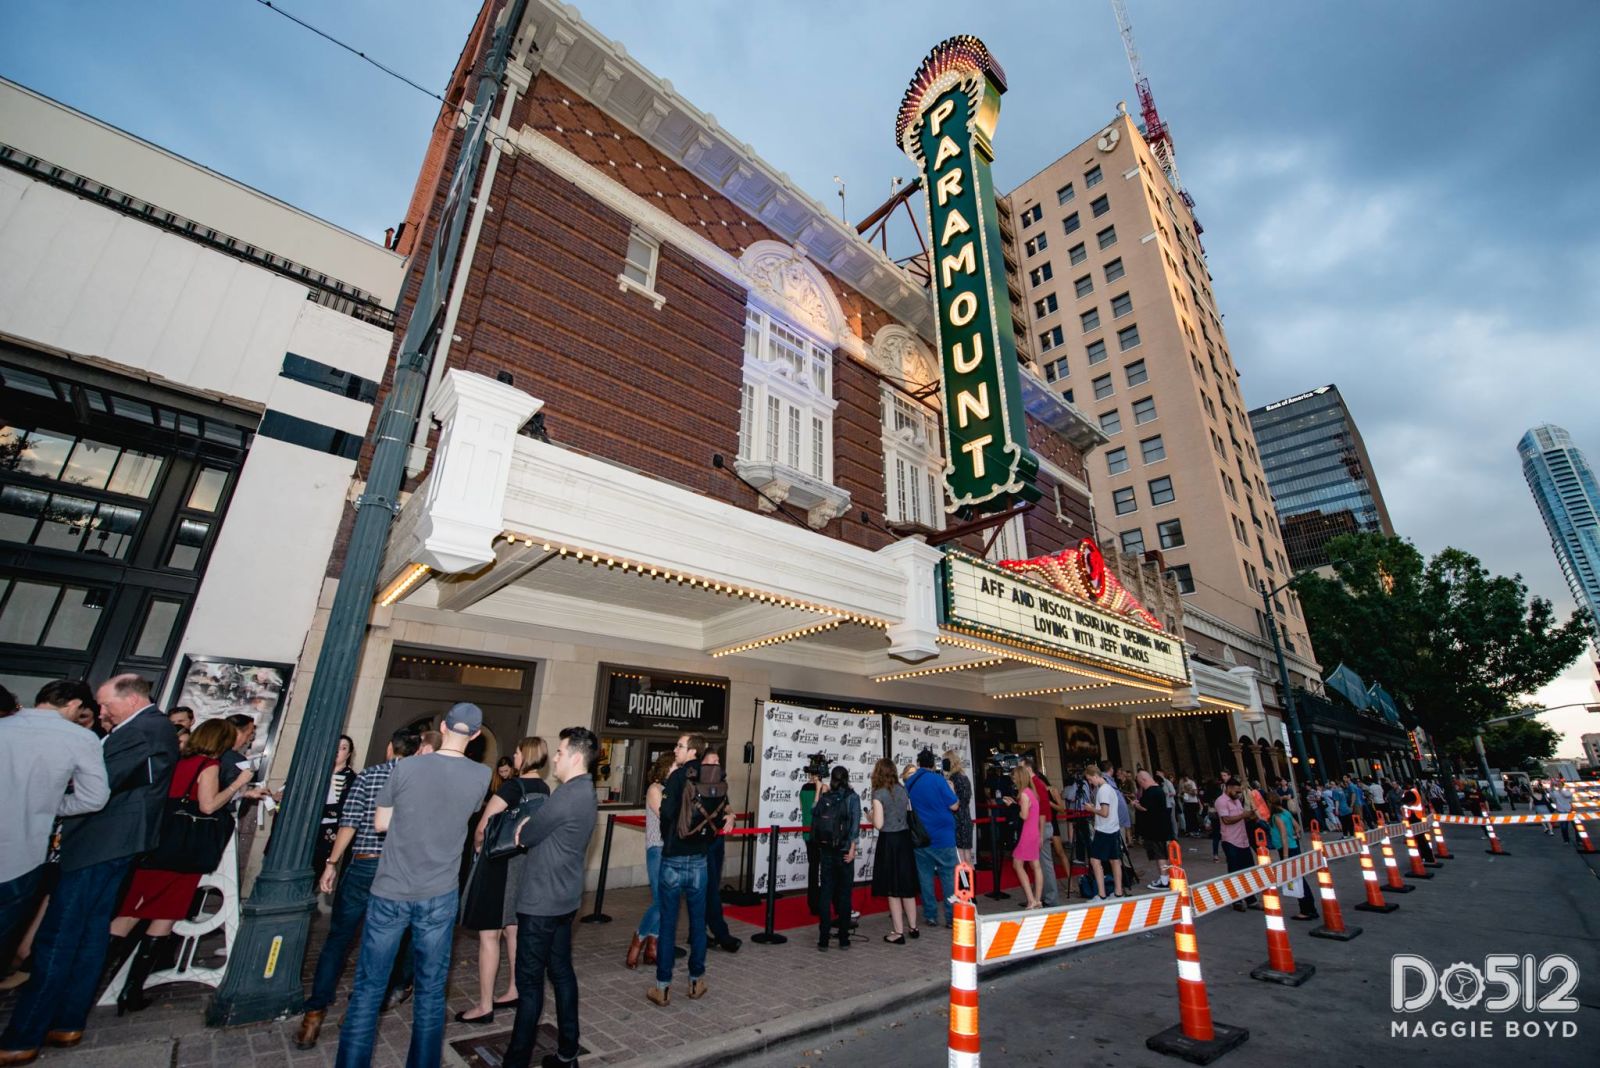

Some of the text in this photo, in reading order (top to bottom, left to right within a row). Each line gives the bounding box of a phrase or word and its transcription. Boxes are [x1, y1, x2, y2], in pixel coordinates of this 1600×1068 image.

[930, 99, 993, 478] PARAMOUNT
[1265, 402, 1281, 411] Bank
[1288, 392, 1314, 404] America
[981, 576, 1005, 598] AFF
[1012, 587, 1035, 608] AND
[1039, 597, 1073, 621] HISCOX
[1075, 610, 1121, 638] INSURANCE
[1123, 628, 1152, 648] OPENING
[1034, 615, 1150, 664] LOVING WITH JEFF NICHOLS
[628, 693, 704, 719] PARAMOUNT
[774, 713, 793, 721] FILM
[770, 792, 792, 800] FILM
